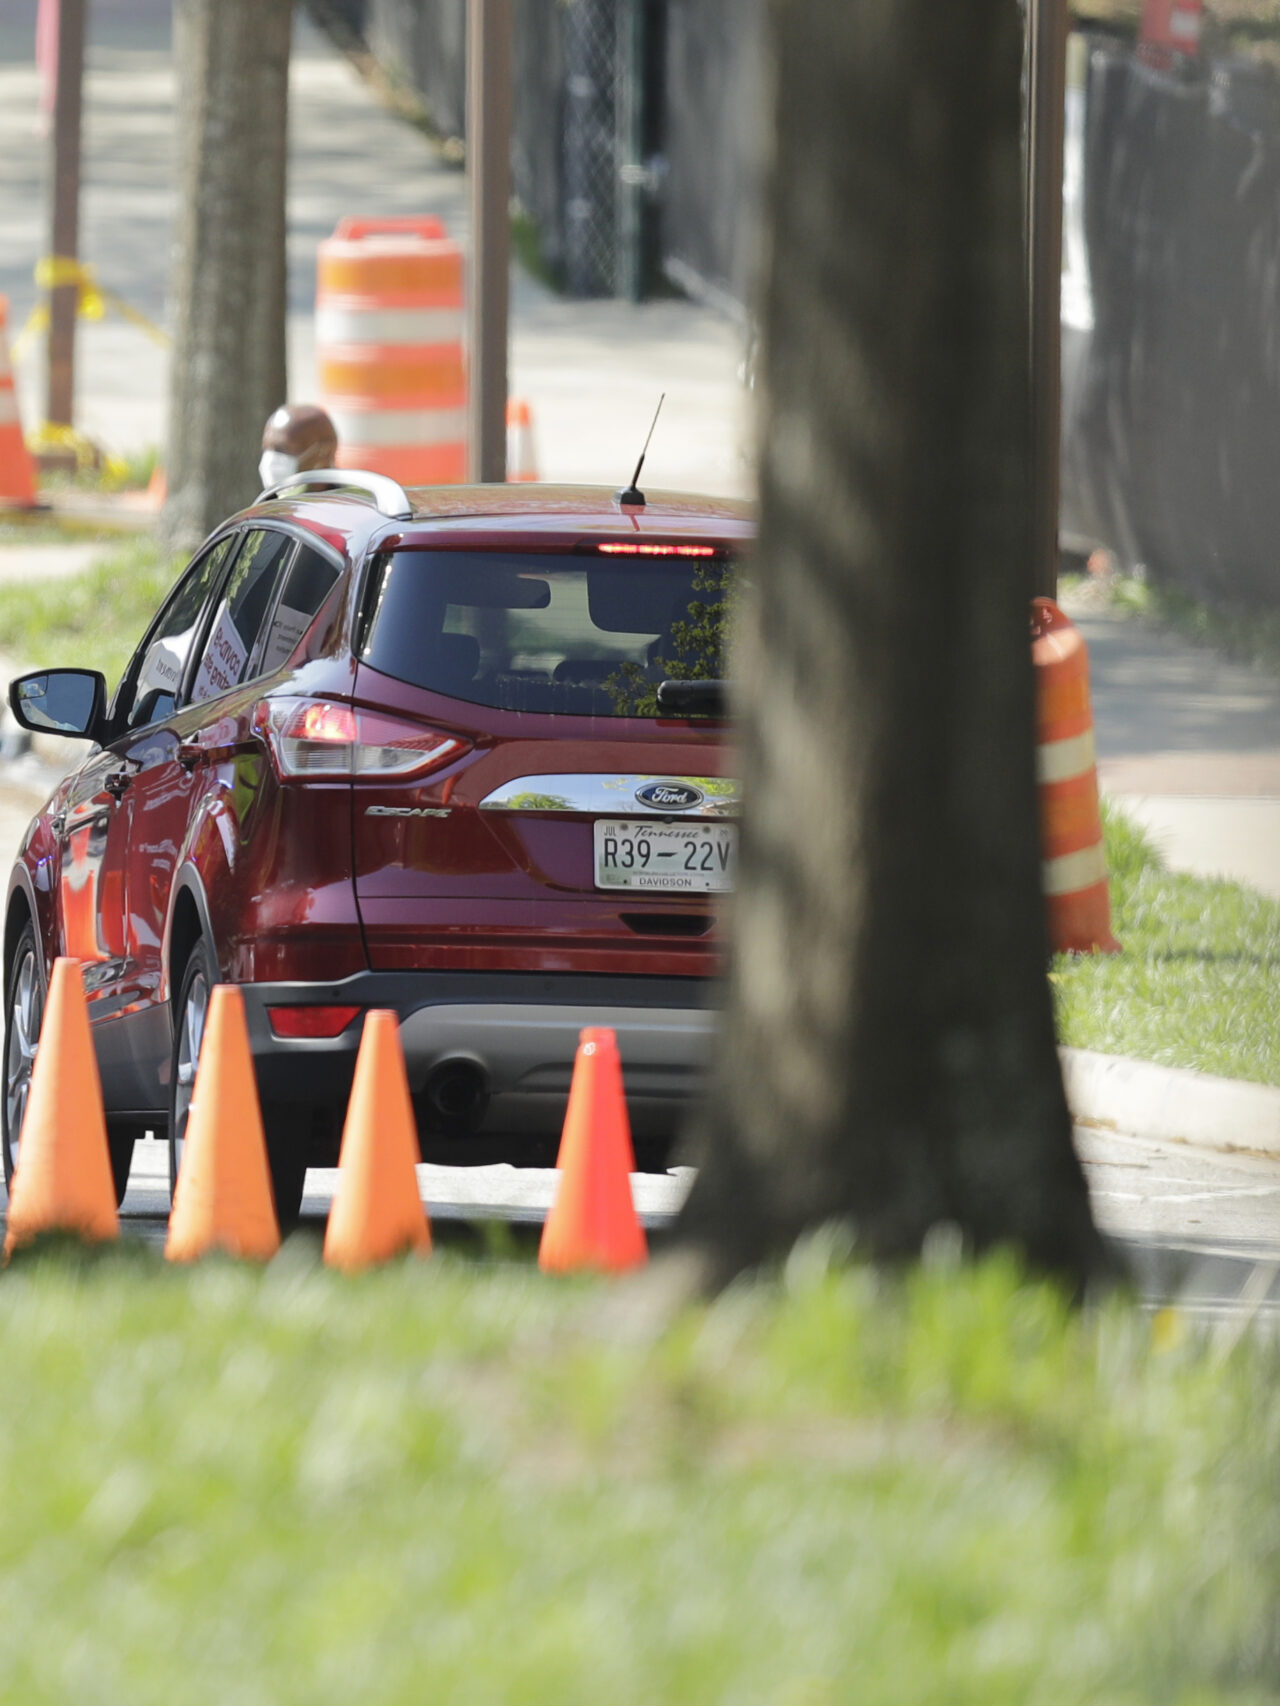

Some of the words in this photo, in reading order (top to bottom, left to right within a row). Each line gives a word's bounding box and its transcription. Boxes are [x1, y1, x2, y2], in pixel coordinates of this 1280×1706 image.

[651, 786, 688, 804] Ford
[604, 826, 617, 837] JUL
[634, 825, 700, 839] Tennessee
[639, 877, 693, 887] DAVIDSON
